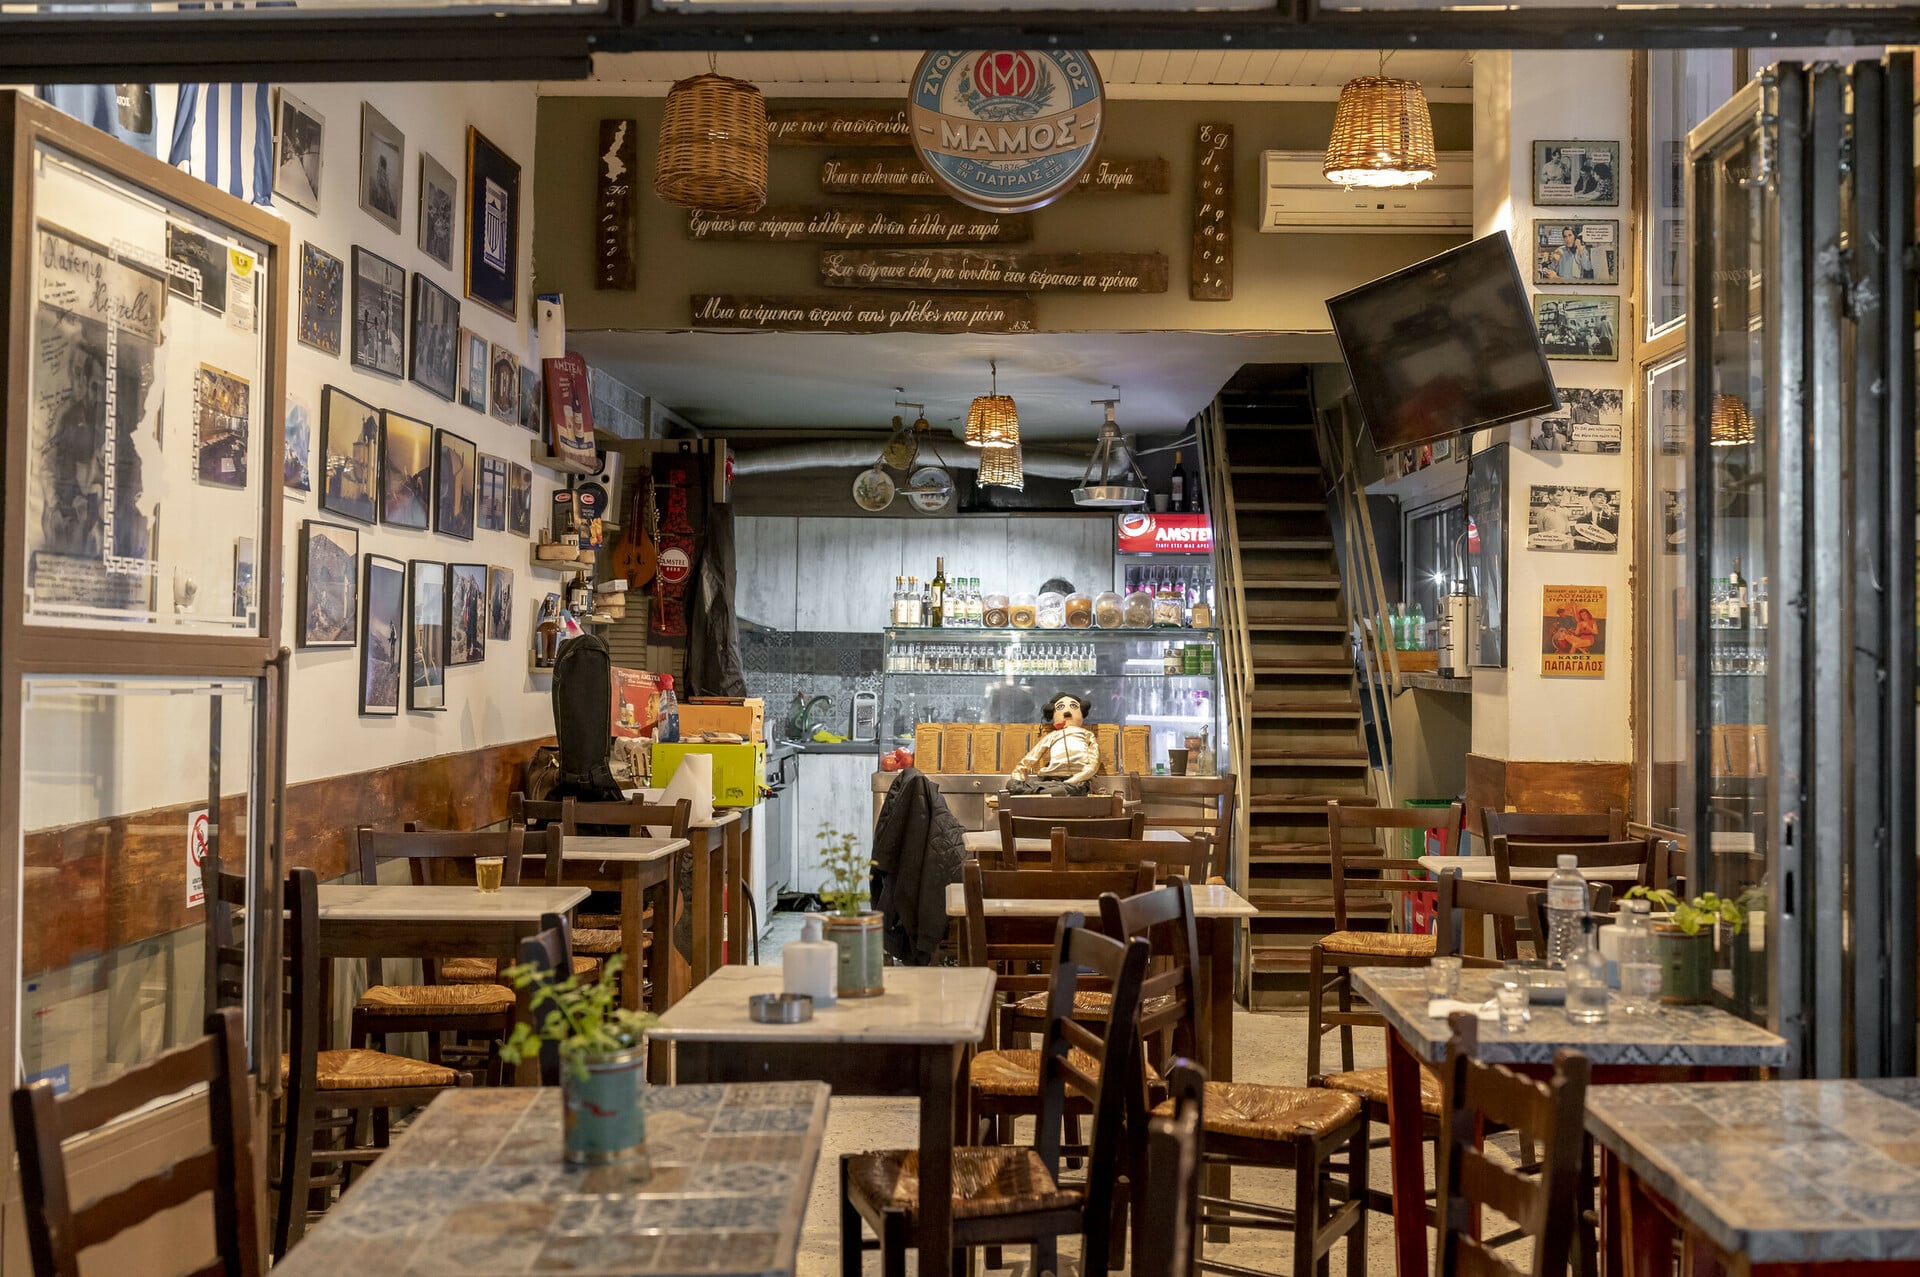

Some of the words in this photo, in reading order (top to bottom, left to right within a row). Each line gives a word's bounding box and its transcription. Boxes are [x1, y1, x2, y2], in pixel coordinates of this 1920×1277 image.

[940, 114, 1077, 154] ΜΑΜΟΣ
[861, 162, 908, 184] τελευταίο
[975, 168, 1043, 185] ΠΑΤΡΑΙΣ
[690, 208, 736, 236] Εργάτες
[738, 219, 756, 232] στο
[758, 216, 806, 238] χάραμα
[808, 211, 847, 234] άλλοι
[845, 223, 865, 239] με
[908, 213, 946, 235] άλλοι
[946, 223, 966, 240] με
[967, 217, 1001, 240] χαρά
[908, 257, 934, 279] έλα
[932, 267, 955, 283] για
[1099, 270, 1139, 292] χρόνια
[695, 296, 735, 320] Μια
[808, 304, 854, 327] περνά
[943, 310, 969, 322] και
[1544, 660, 1603, 671] ΠΑΠΑΓΑΛΟΣ
